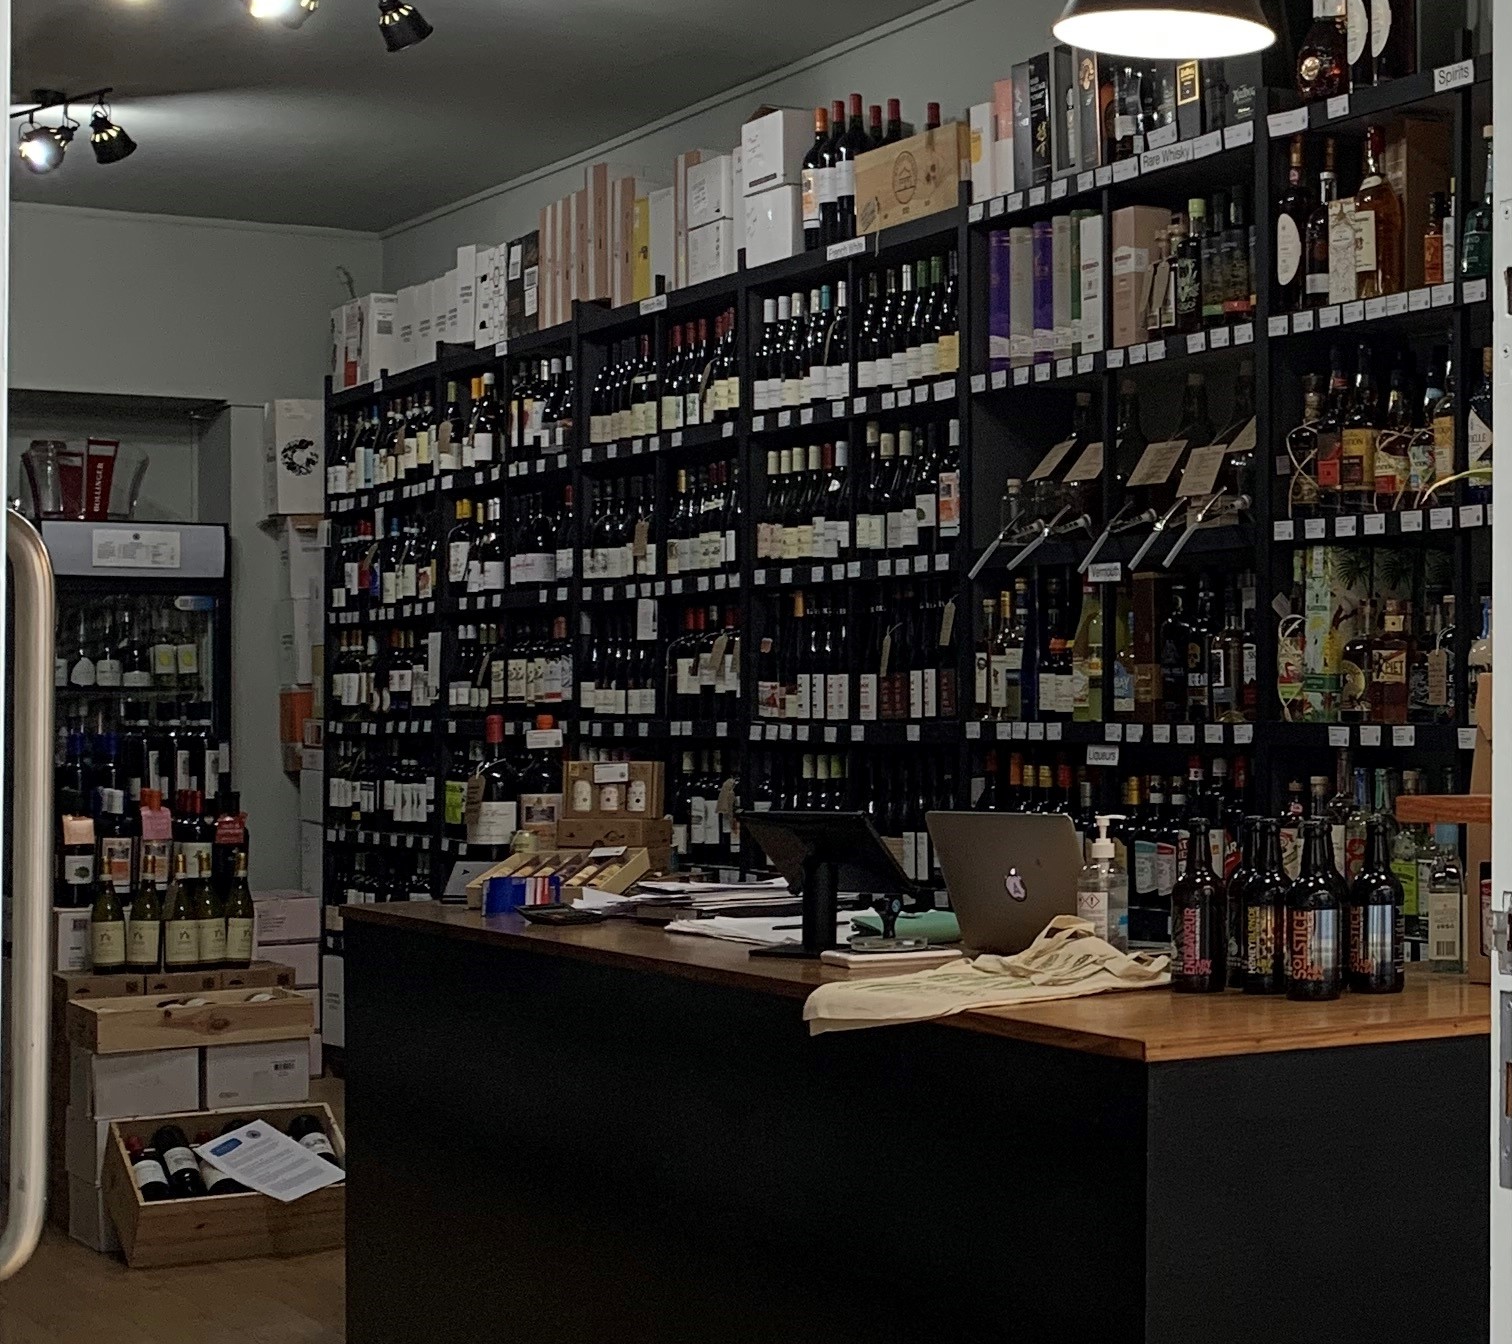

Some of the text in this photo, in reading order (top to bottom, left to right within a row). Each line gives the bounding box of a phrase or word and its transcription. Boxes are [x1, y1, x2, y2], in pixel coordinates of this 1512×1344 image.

[1438, 63, 1470, 87] Spirits
[1143, 144, 1191, 168] Rare Whisky
[1293, 910, 1307, 980] SOLSTICE
